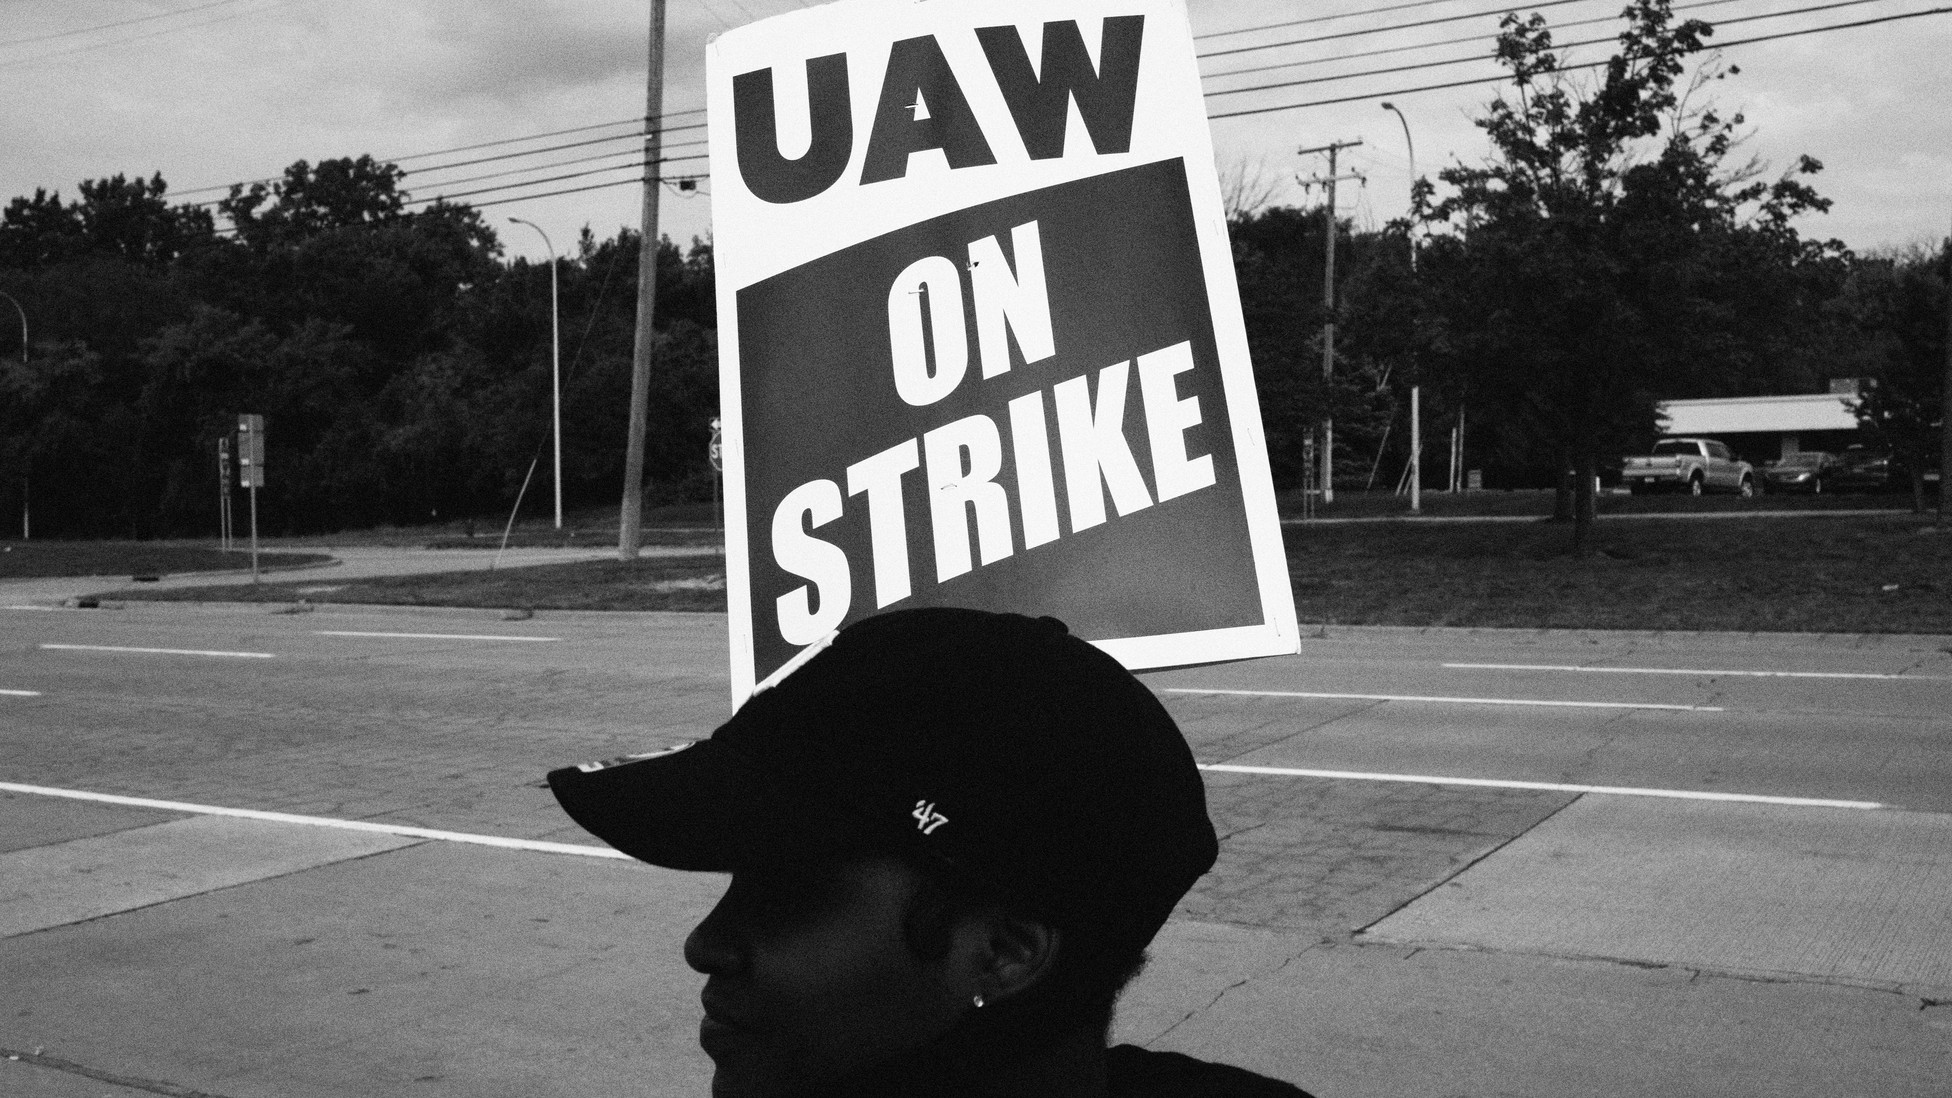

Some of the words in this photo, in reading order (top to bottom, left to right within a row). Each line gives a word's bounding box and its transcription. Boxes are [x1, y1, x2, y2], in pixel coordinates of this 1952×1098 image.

[732, 14, 1145, 204] UAW
[888, 219, 1055, 406] ON
[711, 443, 722, 459] ST
[771, 340, 1216, 646] STRIKE
